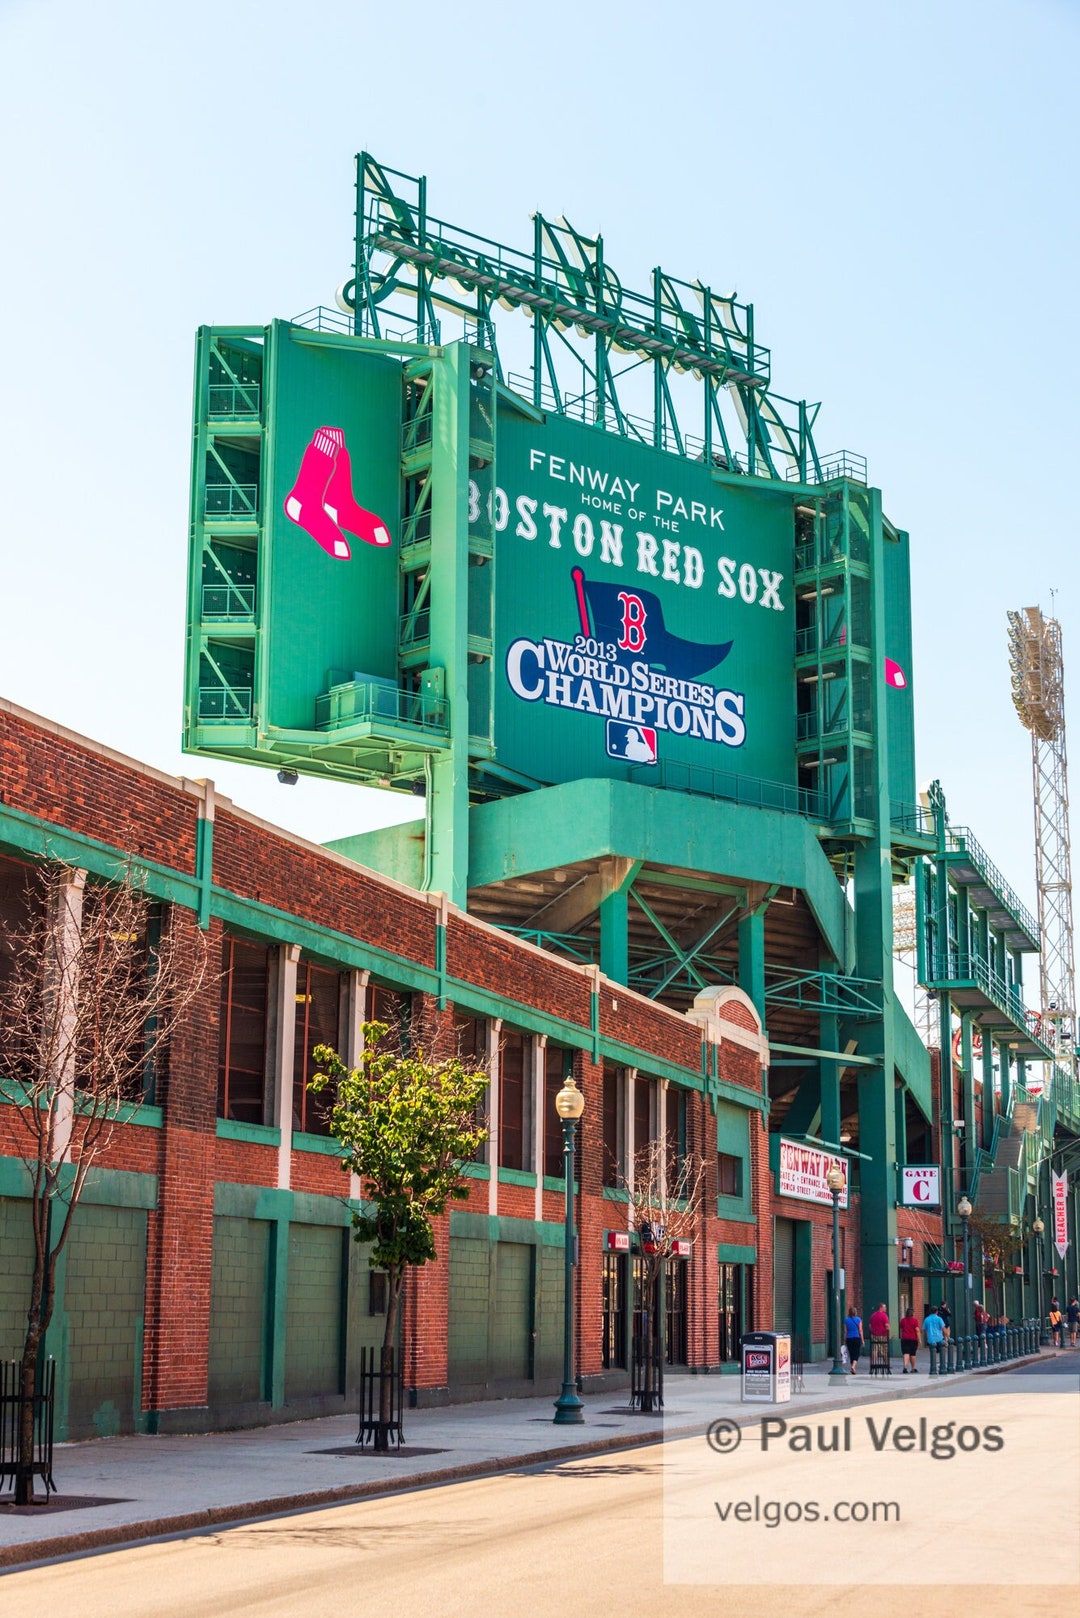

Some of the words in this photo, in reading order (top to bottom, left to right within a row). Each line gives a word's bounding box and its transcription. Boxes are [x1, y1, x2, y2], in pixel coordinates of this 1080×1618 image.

[529, 448, 641, 503] FENWAY
[656, 489, 725, 531] PARK
[581, 492, 622, 516] HOME
[628, 507, 647, 521] OF
[652, 515, 680, 533] THE
[468, 478, 624, 567] BOSTON
[636, 531, 705, 589] RED
[717, 556, 785, 611] SOX
[617, 591, 647, 653] B
[574, 635, 618, 662] 2013
[506, 639, 746, 747] CHAMPIONS
[543, 638, 629, 688] WORLD
[631, 661, 715, 707] SERIES
[780, 1143, 821, 1177] FENWAY
[780, 1181, 795, 1192] PSWICH
[797, 1185, 811, 1195] STREET
[801, 1176, 821, 1189] ENTRANCE
[912, 1180, 930, 1201] C
[1055, 1181, 1064, 1198] BAR
[1056, 1201, 1066, 1243] BLEACHER
